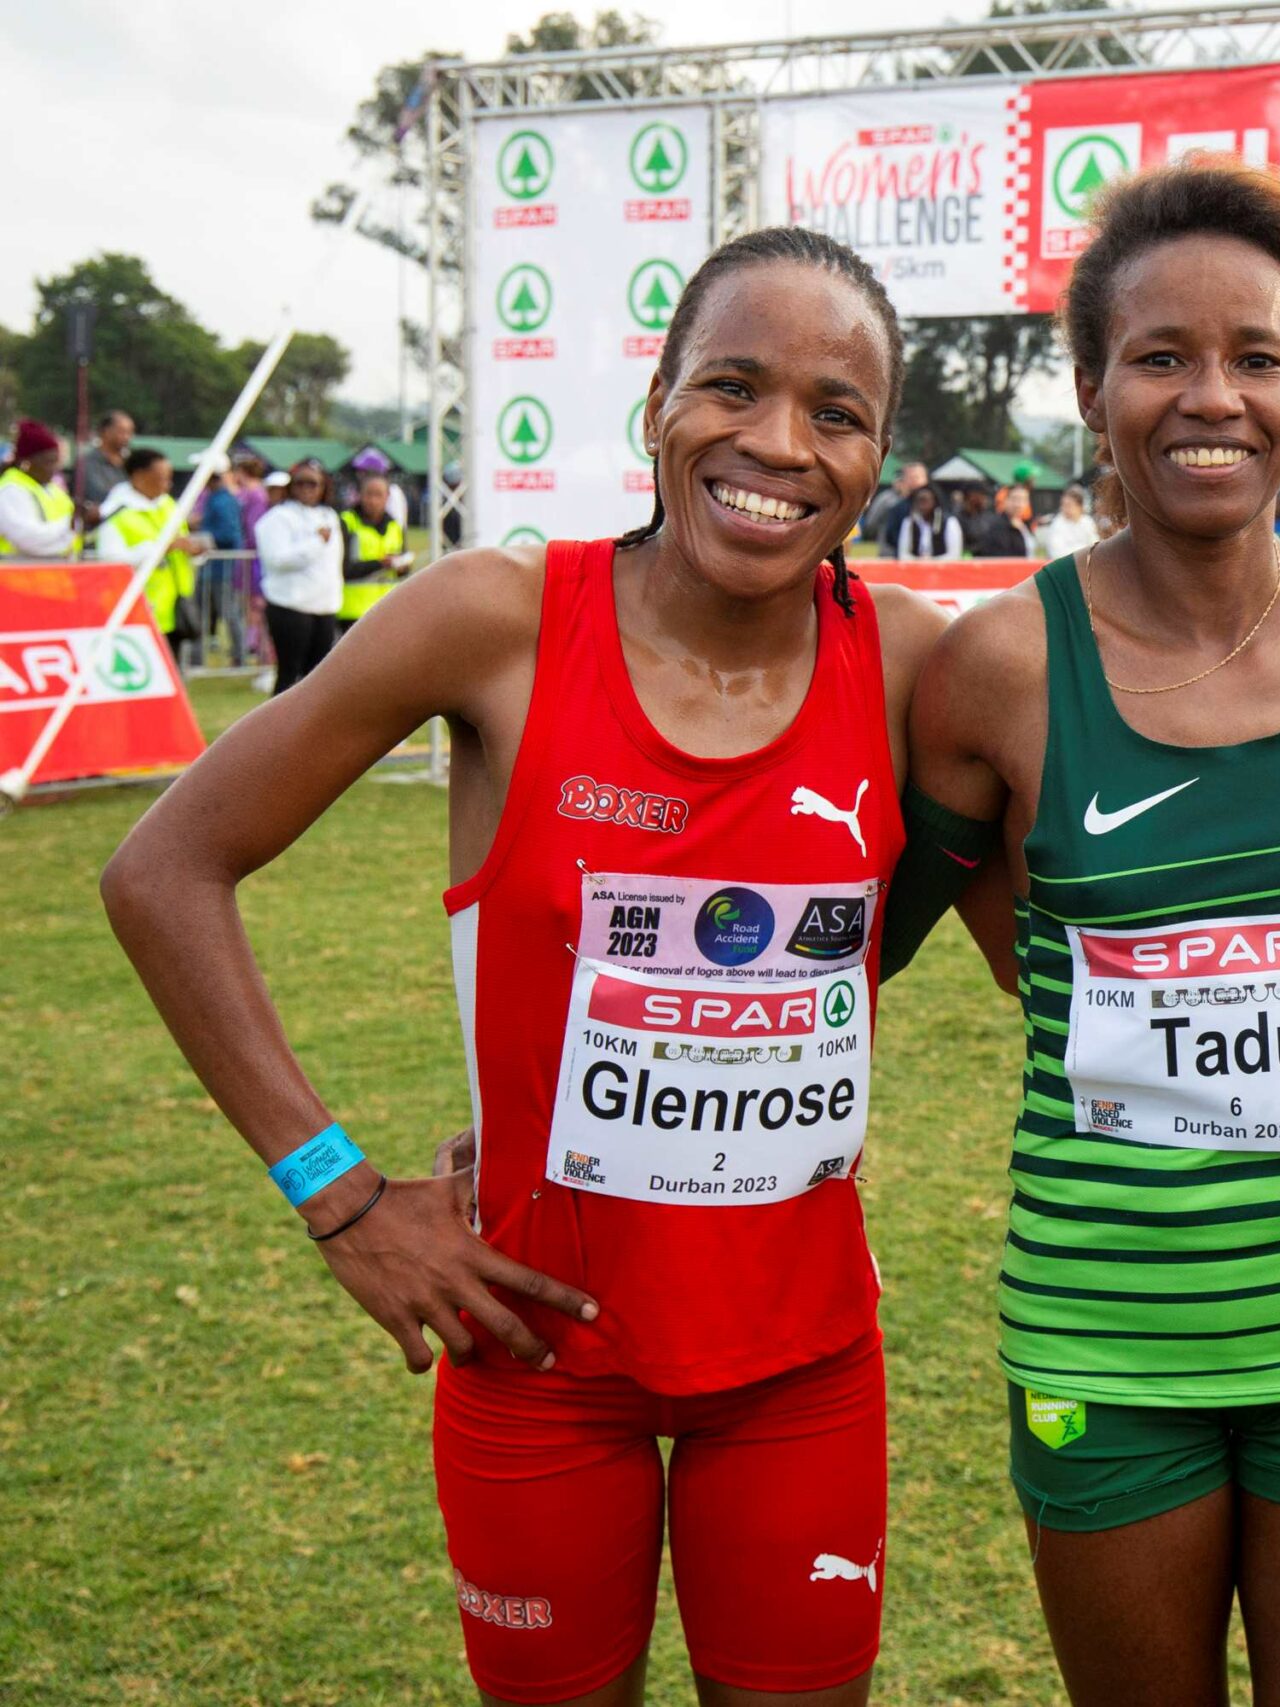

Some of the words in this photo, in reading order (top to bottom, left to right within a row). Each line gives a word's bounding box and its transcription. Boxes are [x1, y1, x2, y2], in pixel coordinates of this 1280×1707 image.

[786, 131, 986, 220] Women's
[558, 775, 689, 834] BOXER
[592, 890, 615, 901] ASA
[618, 892, 647, 902] License
[649, 893, 674, 903] issued
[676, 894, 685, 905] by
[609, 905, 661, 930] AGN
[802, 905, 863, 933] ASA
[732, 923, 760, 933] Road
[606, 931, 658, 957] 2023
[714, 934, 759, 943] Accident
[643, 966, 682, 976] removal
[685, 966, 695, 976] of
[697, 966, 723, 978] logos
[726, 968, 755, 978] above
[758, 968, 773, 978] will
[776, 968, 796, 978] lead
[798, 969, 808, 978] to
[1085, 988, 1135, 1008] 10KM
[643, 993, 813, 1031] SPAR
[582, 1029, 638, 1057] 10KM
[817, 1034, 857, 1059] 10KM
[582, 1060, 856, 1133] Glenrose
[1091, 1099, 1126, 1111] GENDER
[1091, 1107, 1120, 1119] BASED
[1230, 1097, 1242, 1118] 6
[1091, 1116, 1133, 1129] VIOLENCE
[1174, 1117, 1247, 1139] Durban
[564, 1158, 593, 1174] BASED
[566, 1150, 600, 1166] GENDER
[713, 1152, 726, 1171] 2
[563, 1166, 606, 1184] VIOLENCE
[815, 1158, 843, 1178] ASA
[650, 1175, 725, 1194] Durban
[732, 1176, 777, 1193] 2023
[1031, 1400, 1078, 1410] RUNNING
[1031, 1413, 1058, 1422] CLUB
